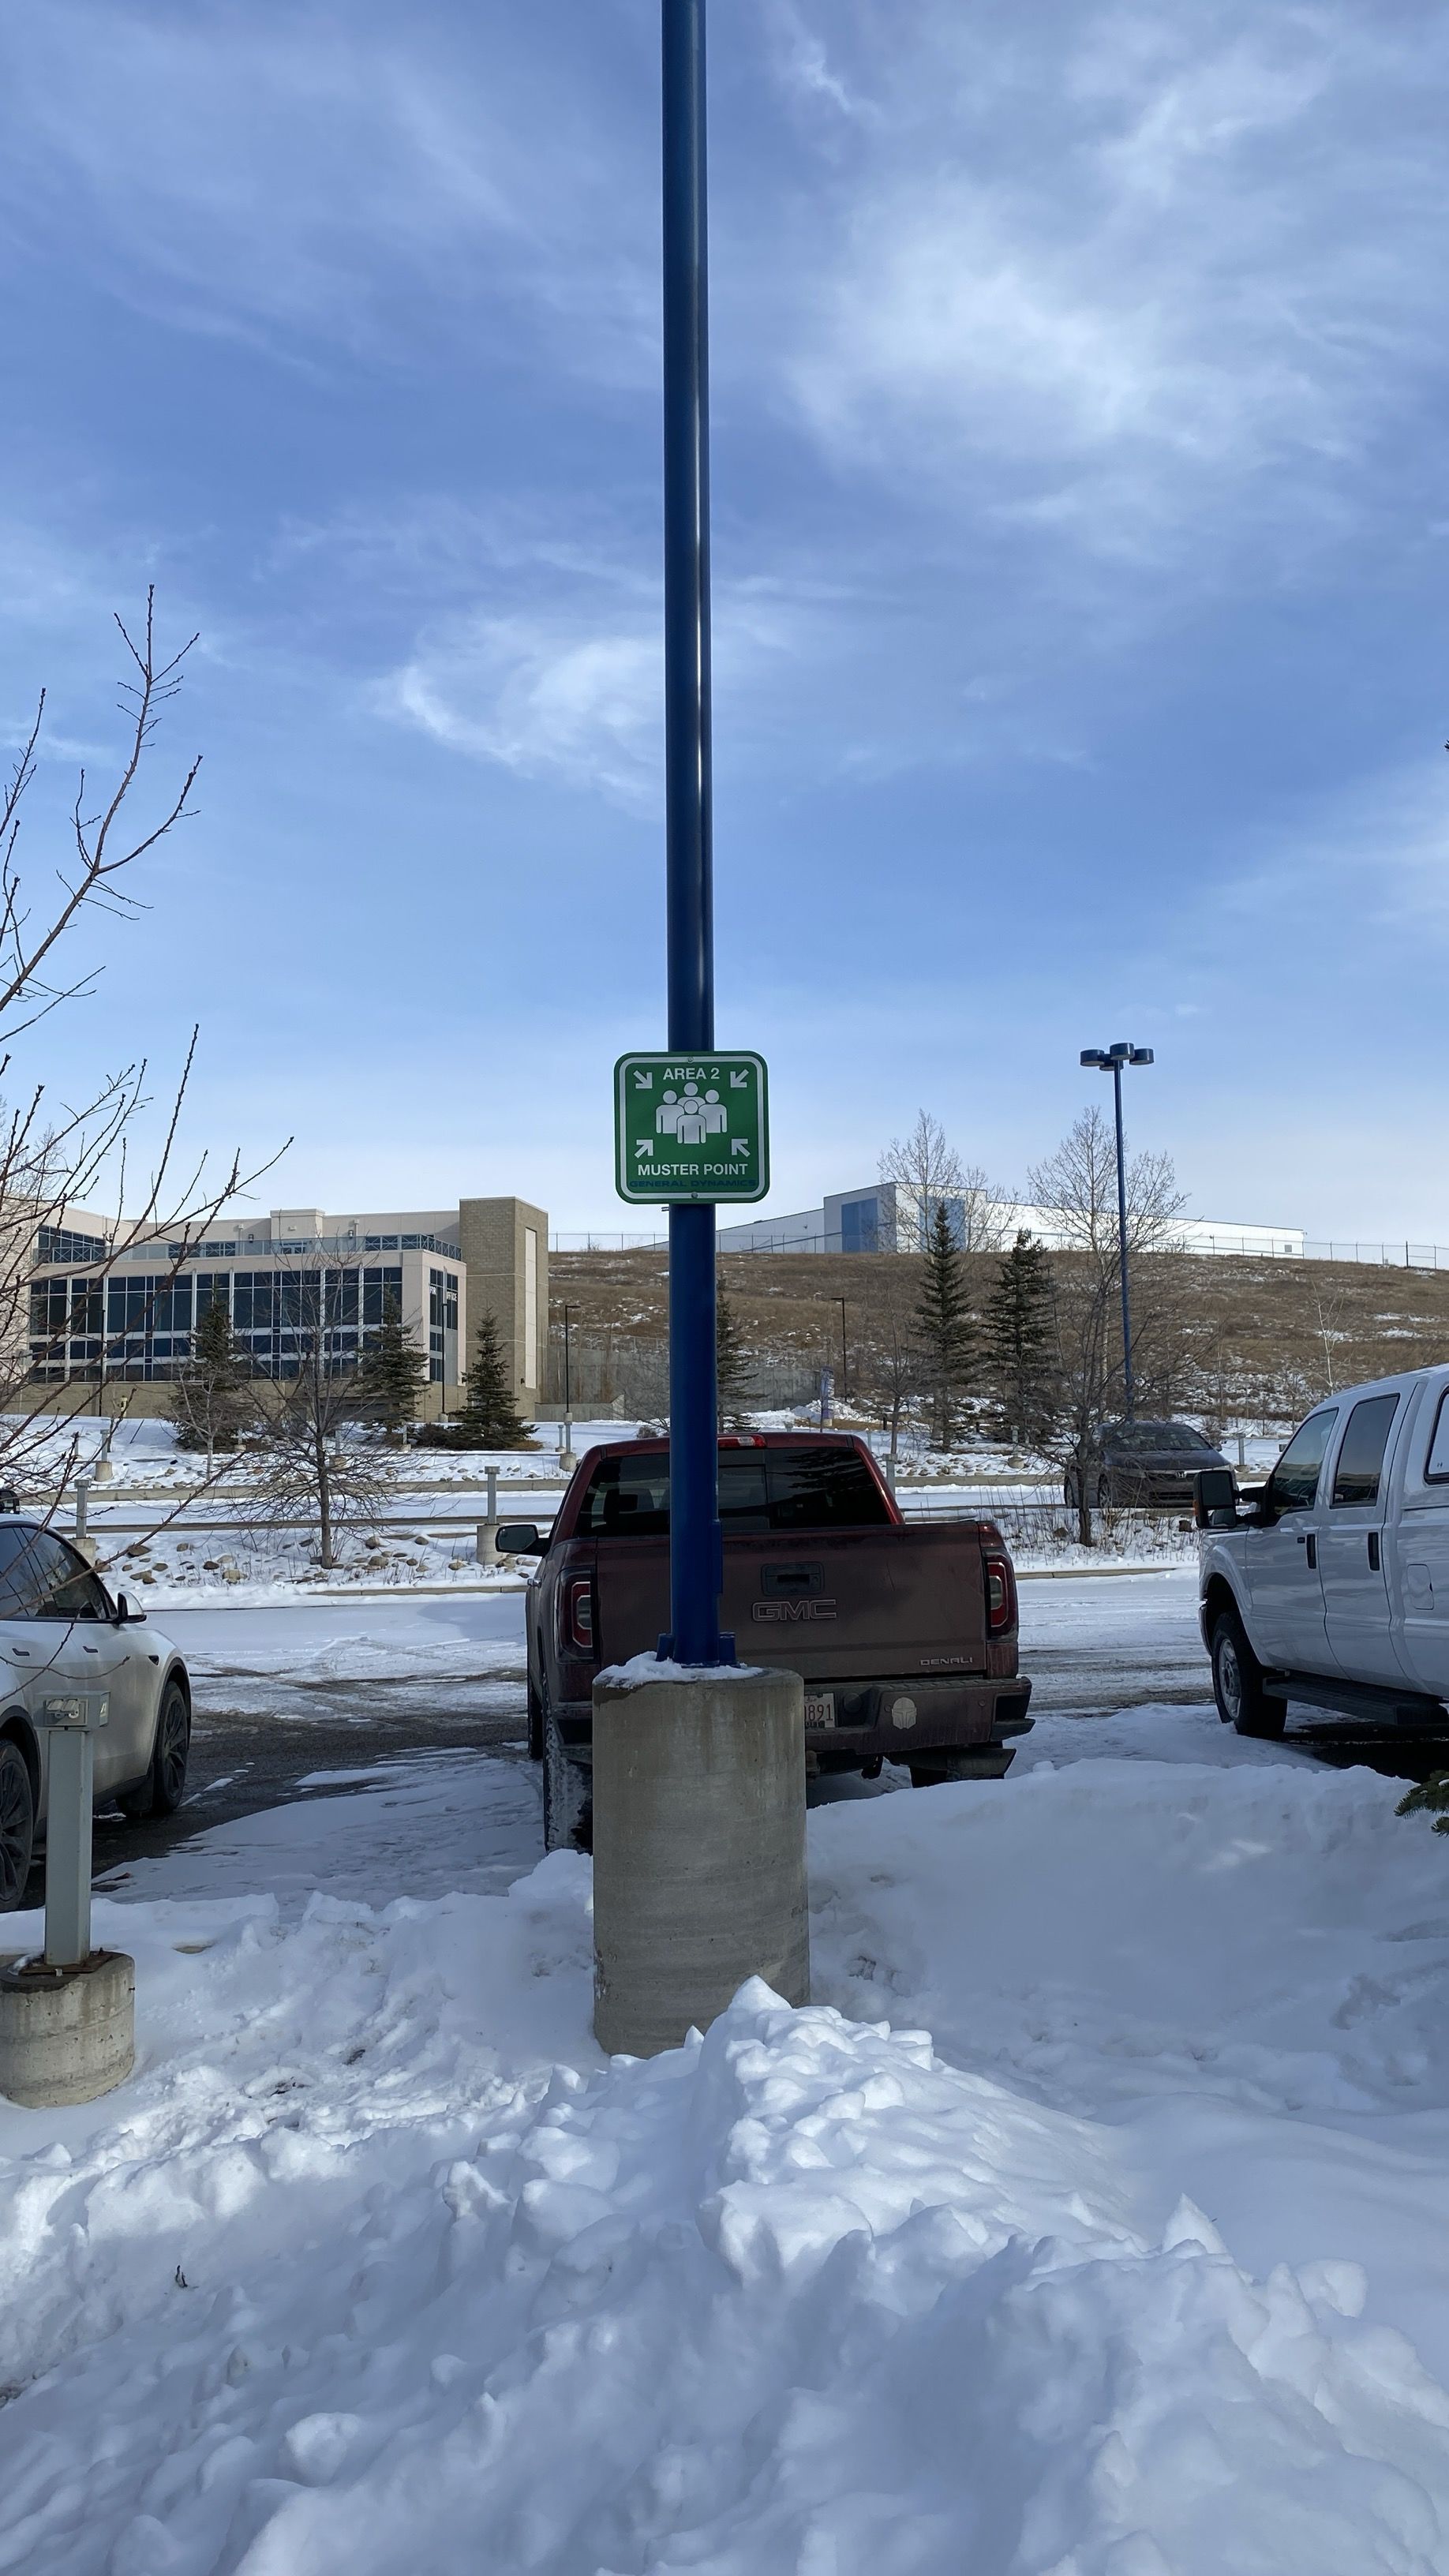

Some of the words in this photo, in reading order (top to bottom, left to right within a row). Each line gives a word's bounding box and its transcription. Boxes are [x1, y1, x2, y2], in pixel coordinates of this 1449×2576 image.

[663, 1068, 706, 1080] AREA
[710, 1067, 720, 1079] 2
[638, 1164, 698, 1175] MUSTER
[704, 1163, 748, 1175] POINT
[752, 1599, 837, 1622] GMC
[919, 1657, 973, 1666] DENALI
[804, 1703, 833, 1721] 891
